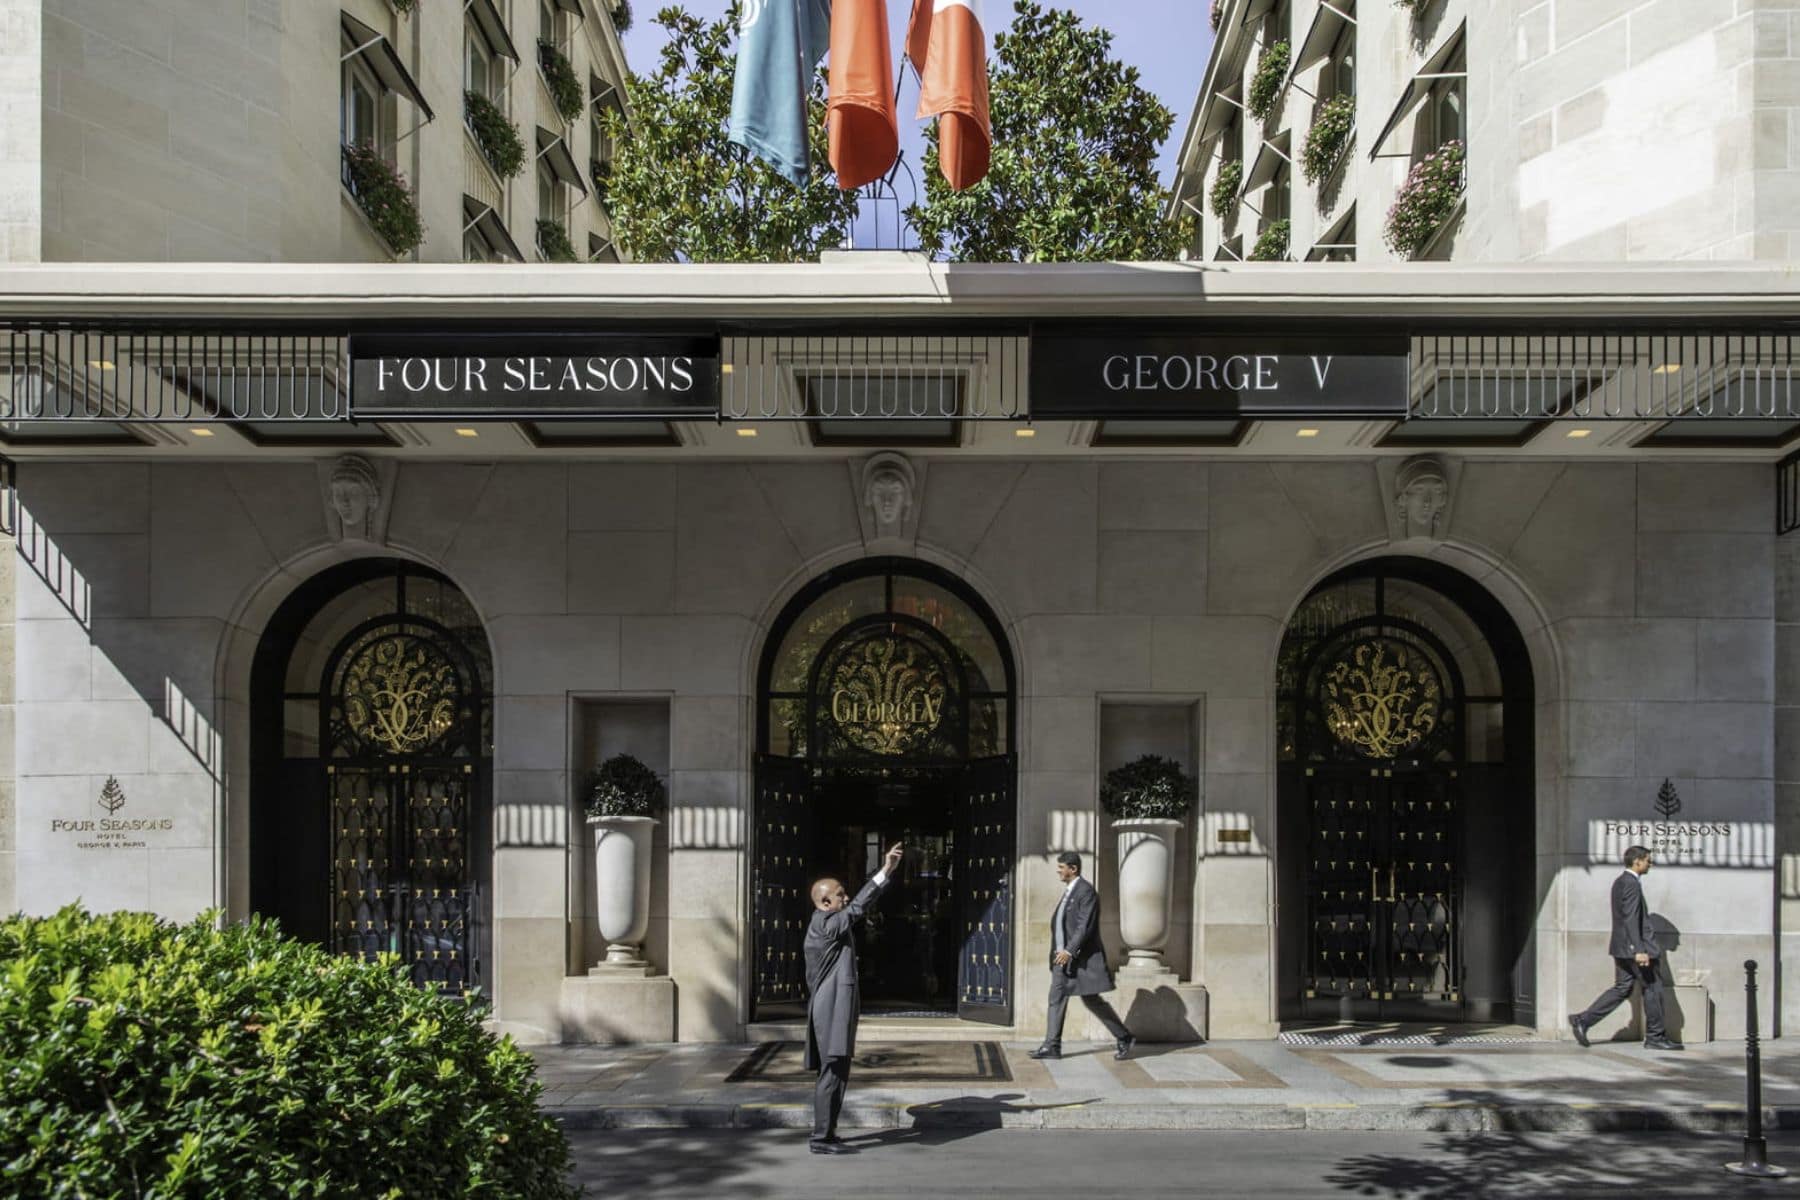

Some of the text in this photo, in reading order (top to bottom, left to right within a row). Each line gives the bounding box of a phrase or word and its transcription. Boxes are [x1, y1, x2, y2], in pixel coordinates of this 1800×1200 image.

[377, 356, 694, 392] FOUR SEASONS
[1102, 355, 1333, 391] GEORGE V
[51, 818, 173, 832] FOUR SEASONS
[1605, 823, 1732, 837] FOUR SEASONS
